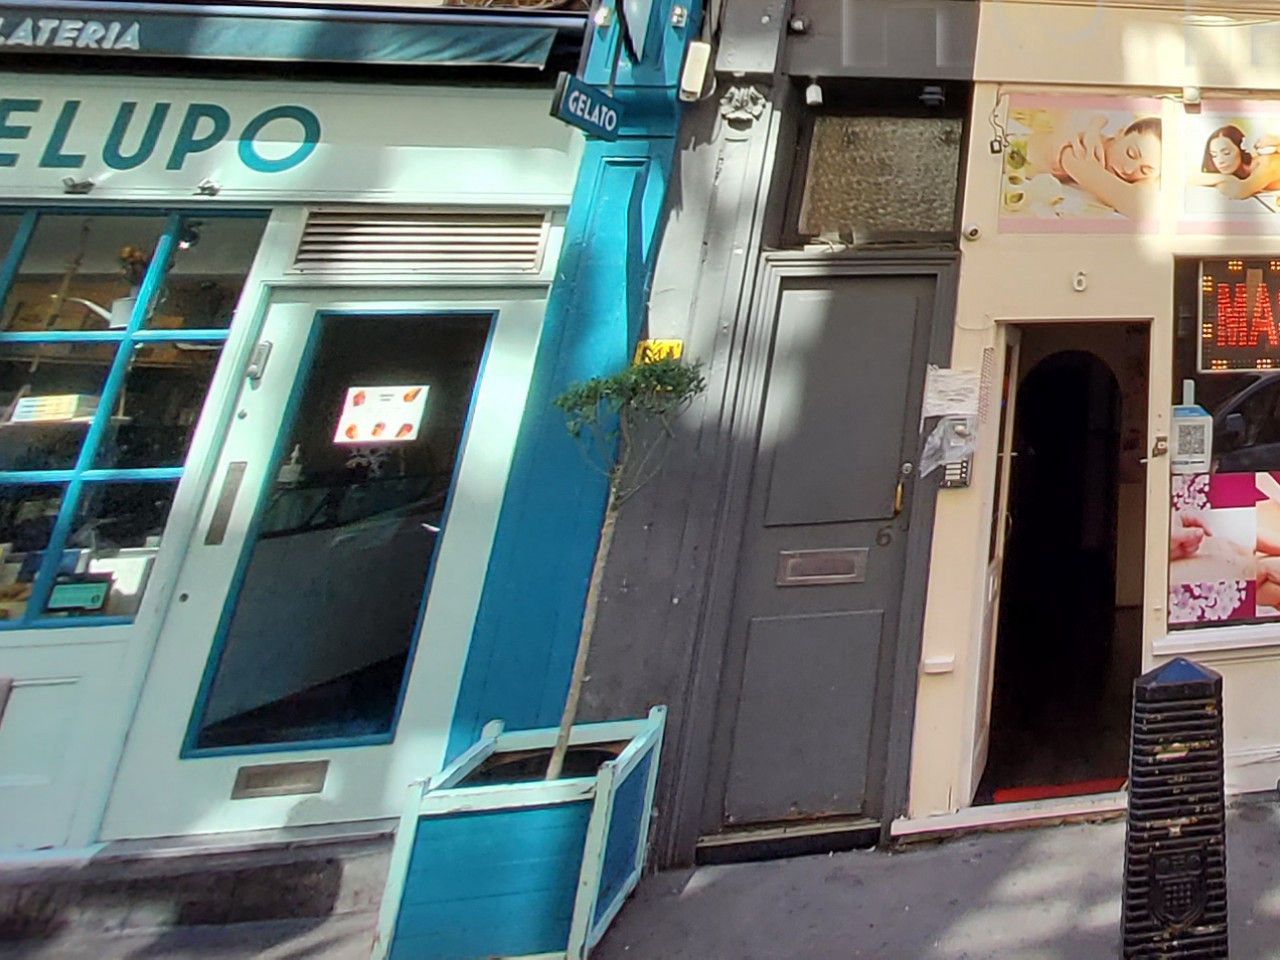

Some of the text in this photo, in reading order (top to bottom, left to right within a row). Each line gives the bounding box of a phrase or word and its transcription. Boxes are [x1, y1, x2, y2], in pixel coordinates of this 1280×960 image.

[568, 90, 617, 132] GELATO
[0, 97, 321, 172] ELUPO
[1072, 270, 1087, 292] 6
[875, 524, 893, 547] 6
